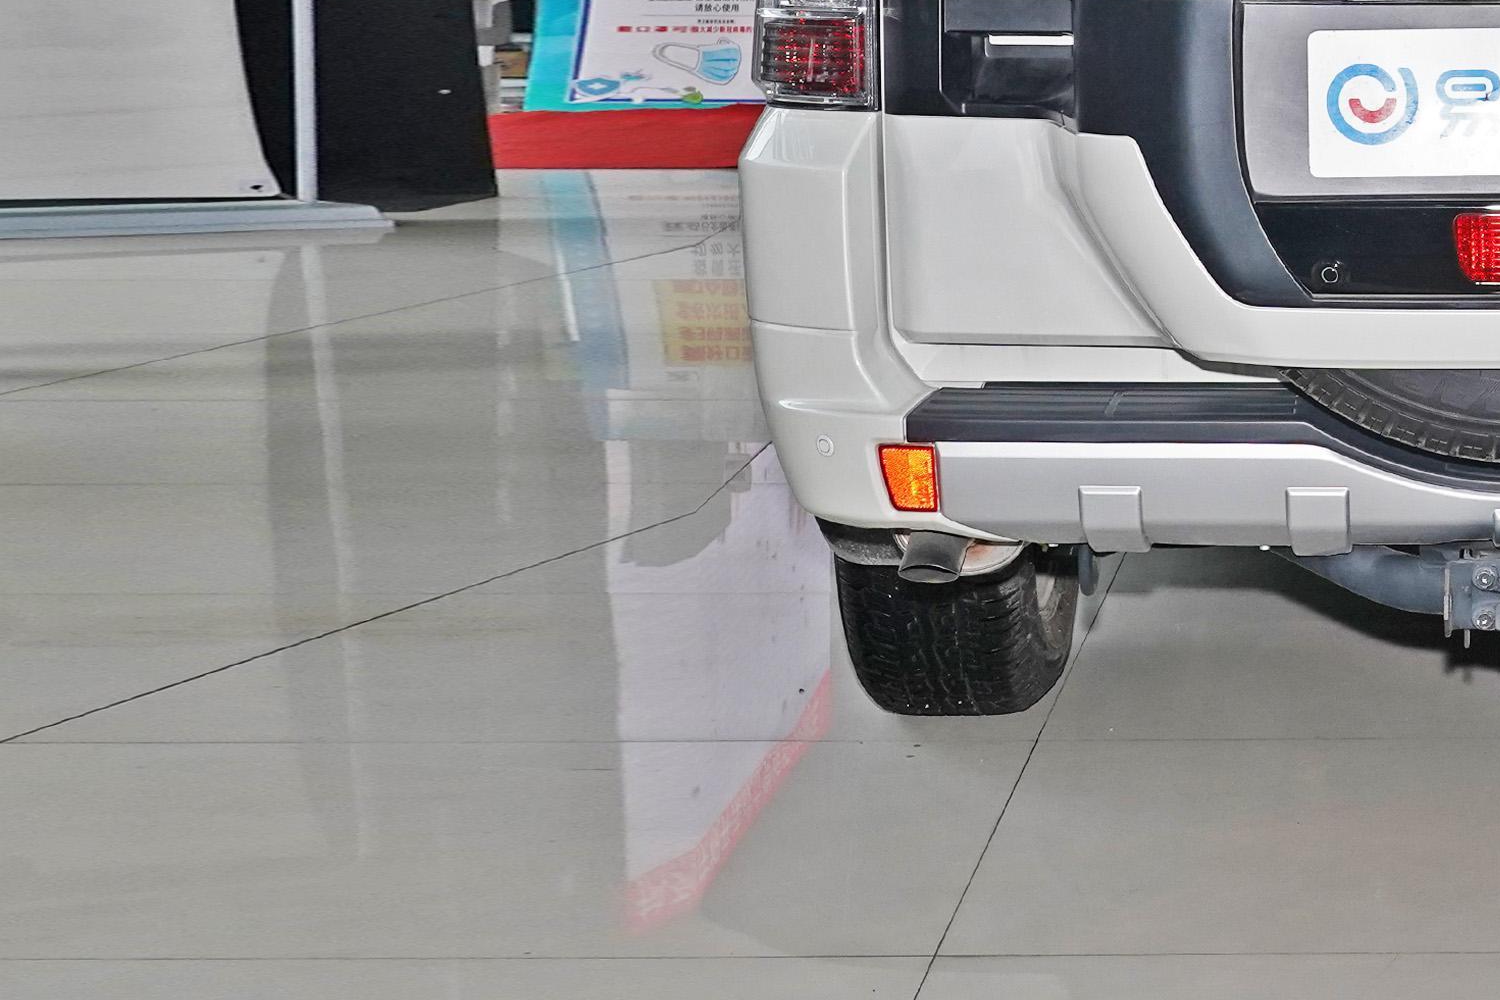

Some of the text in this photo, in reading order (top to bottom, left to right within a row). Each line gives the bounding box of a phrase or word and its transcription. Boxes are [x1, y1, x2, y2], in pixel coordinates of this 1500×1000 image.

[695, 3, 740, 12] 请放心使用
